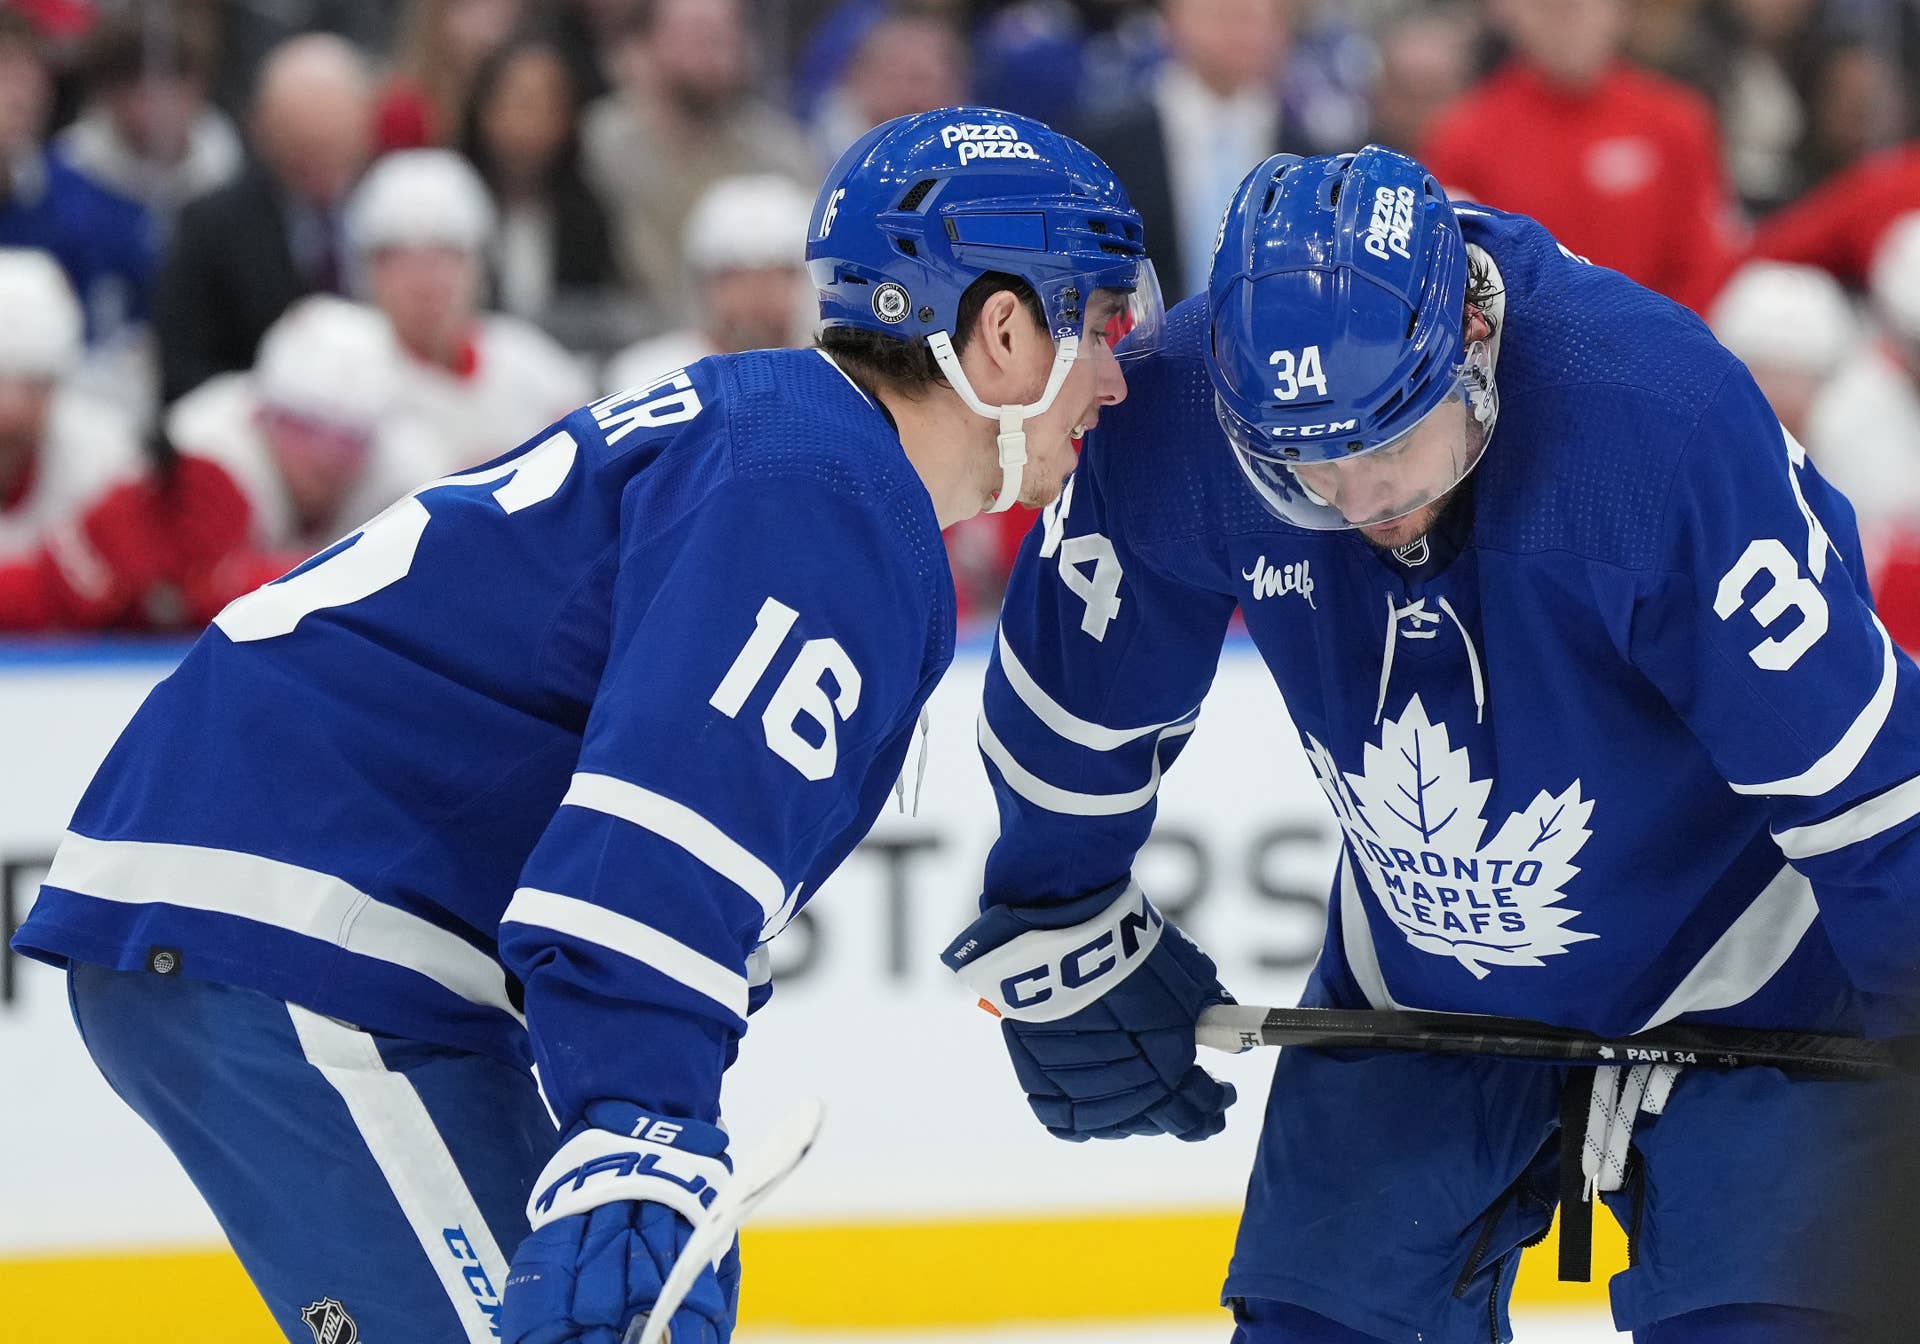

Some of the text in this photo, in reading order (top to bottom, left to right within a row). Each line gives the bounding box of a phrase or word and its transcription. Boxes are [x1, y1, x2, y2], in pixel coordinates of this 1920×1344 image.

[941, 125, 1018, 148] pizza
[958, 141, 1040, 166] pizza
[818, 188, 846, 237] 16
[1365, 186, 1395, 260] pizza
[1388, 186, 1415, 260] pizza
[1269, 345, 1328, 400] 34
[1271, 419, 1356, 437] CCM
[1242, 555, 1317, 609] Milk
[709, 596, 862, 781] 16
[1351, 828, 1542, 886] TORONTO
[1380, 867, 1518, 908] MAPLE
[1389, 891, 1526, 934] LEAFS
[1000, 900, 1163, 1009] CCM
[1626, 1048, 1697, 1064] PAPI 34
[630, 1116, 683, 1145] 16
[442, 1224, 503, 1338] CCM
[323, 1311, 341, 1344] NHL
